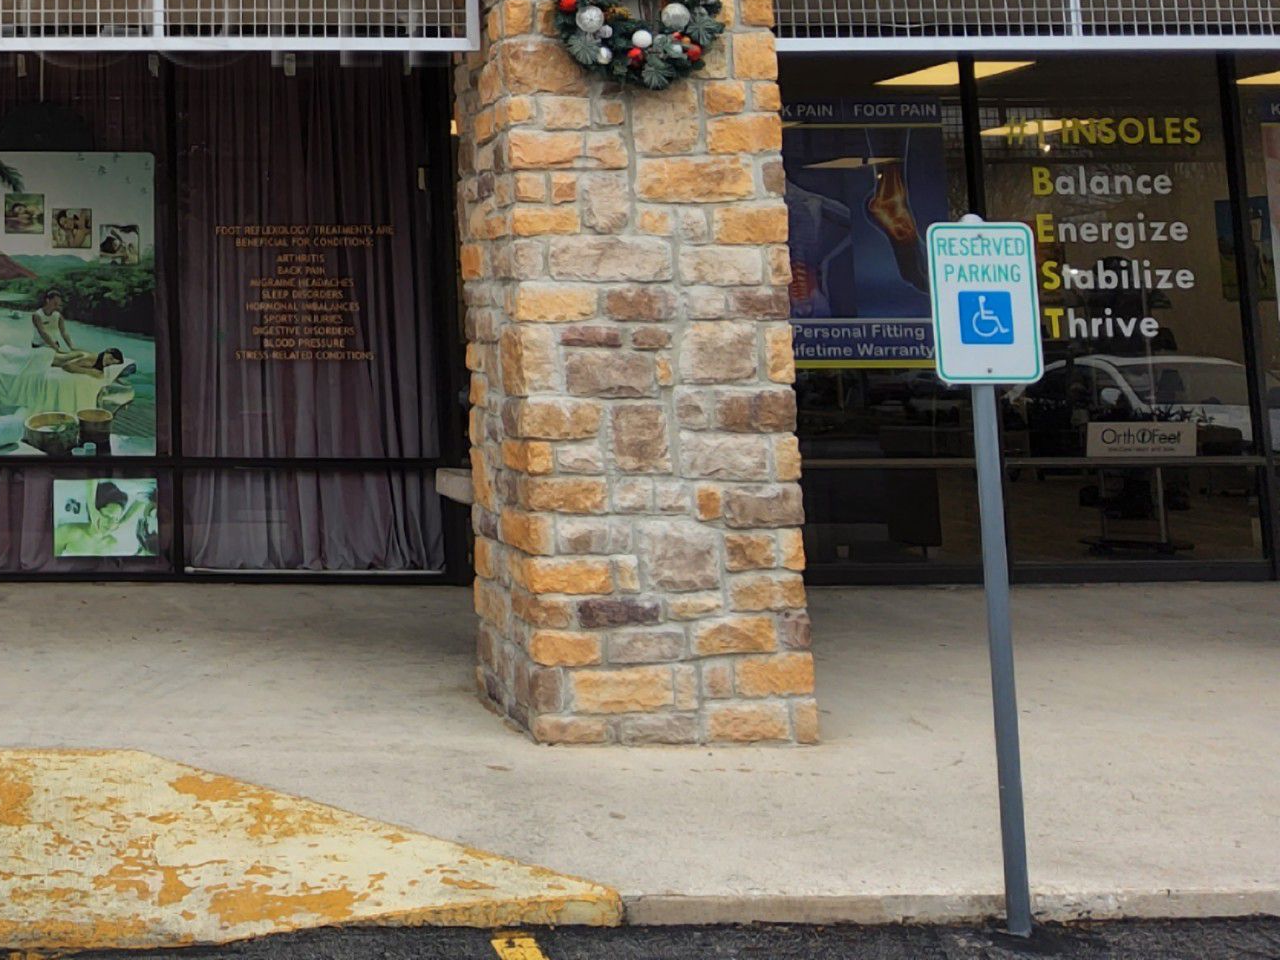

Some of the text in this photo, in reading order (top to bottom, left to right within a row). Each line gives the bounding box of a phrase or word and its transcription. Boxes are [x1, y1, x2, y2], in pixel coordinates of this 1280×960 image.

[797, 104, 834, 117] PAIN
[854, 103, 937, 117] FOOT PAIN
[1062, 117, 1202, 145] INSOLES
[1032, 165, 1173, 196] Balance
[216, 225, 241, 236] FOOT
[244, 225, 310, 236] REFLEXOLOGY
[313, 224, 373, 236] TREATMENTS
[1036, 212, 1189, 249] Energize
[291, 237, 310, 248] FOR
[936, 237, 1025, 256] RESERVED
[276, 254, 325, 263] ARTHRITIS
[943, 264, 1021, 283] PARKING
[1041, 259, 1195, 290] Stabilize
[261, 290, 290, 299] SLEEP
[1044, 307, 1160, 339] Thrive
[252, 326, 355, 336] DIGESTIVE DISORDERS
[793, 324, 926, 340] Personal Fitting
[263, 338, 345, 348] BLOOD PRESSURE
[315, 350, 375, 360] CONDITIONS
[794, 343, 935, 358] ifetime Warranty
